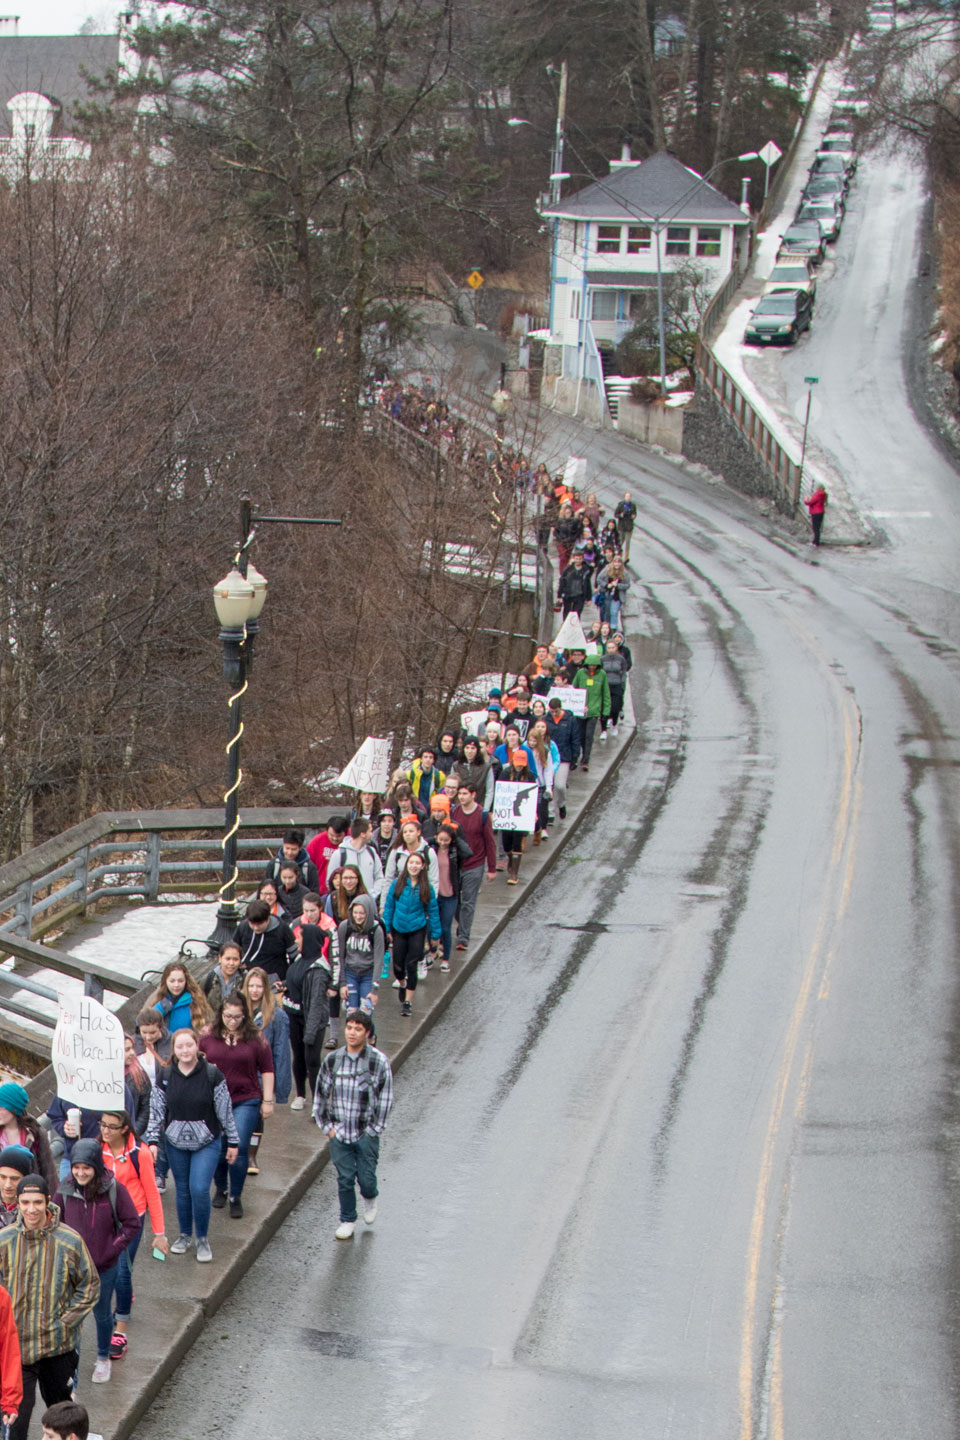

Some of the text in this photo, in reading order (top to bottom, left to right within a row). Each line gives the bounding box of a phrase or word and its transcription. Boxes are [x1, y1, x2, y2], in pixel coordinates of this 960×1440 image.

[371, 756, 383, 771] BE
[347, 767, 382, 790] NEXT
[494, 819, 517, 830] Guns
[495, 808, 512, 819] NOT
[79, 1002, 115, 1031] Has
[57, 1032, 123, 1061] No Place In
[57, 1063, 124, 1094] Our Schools
